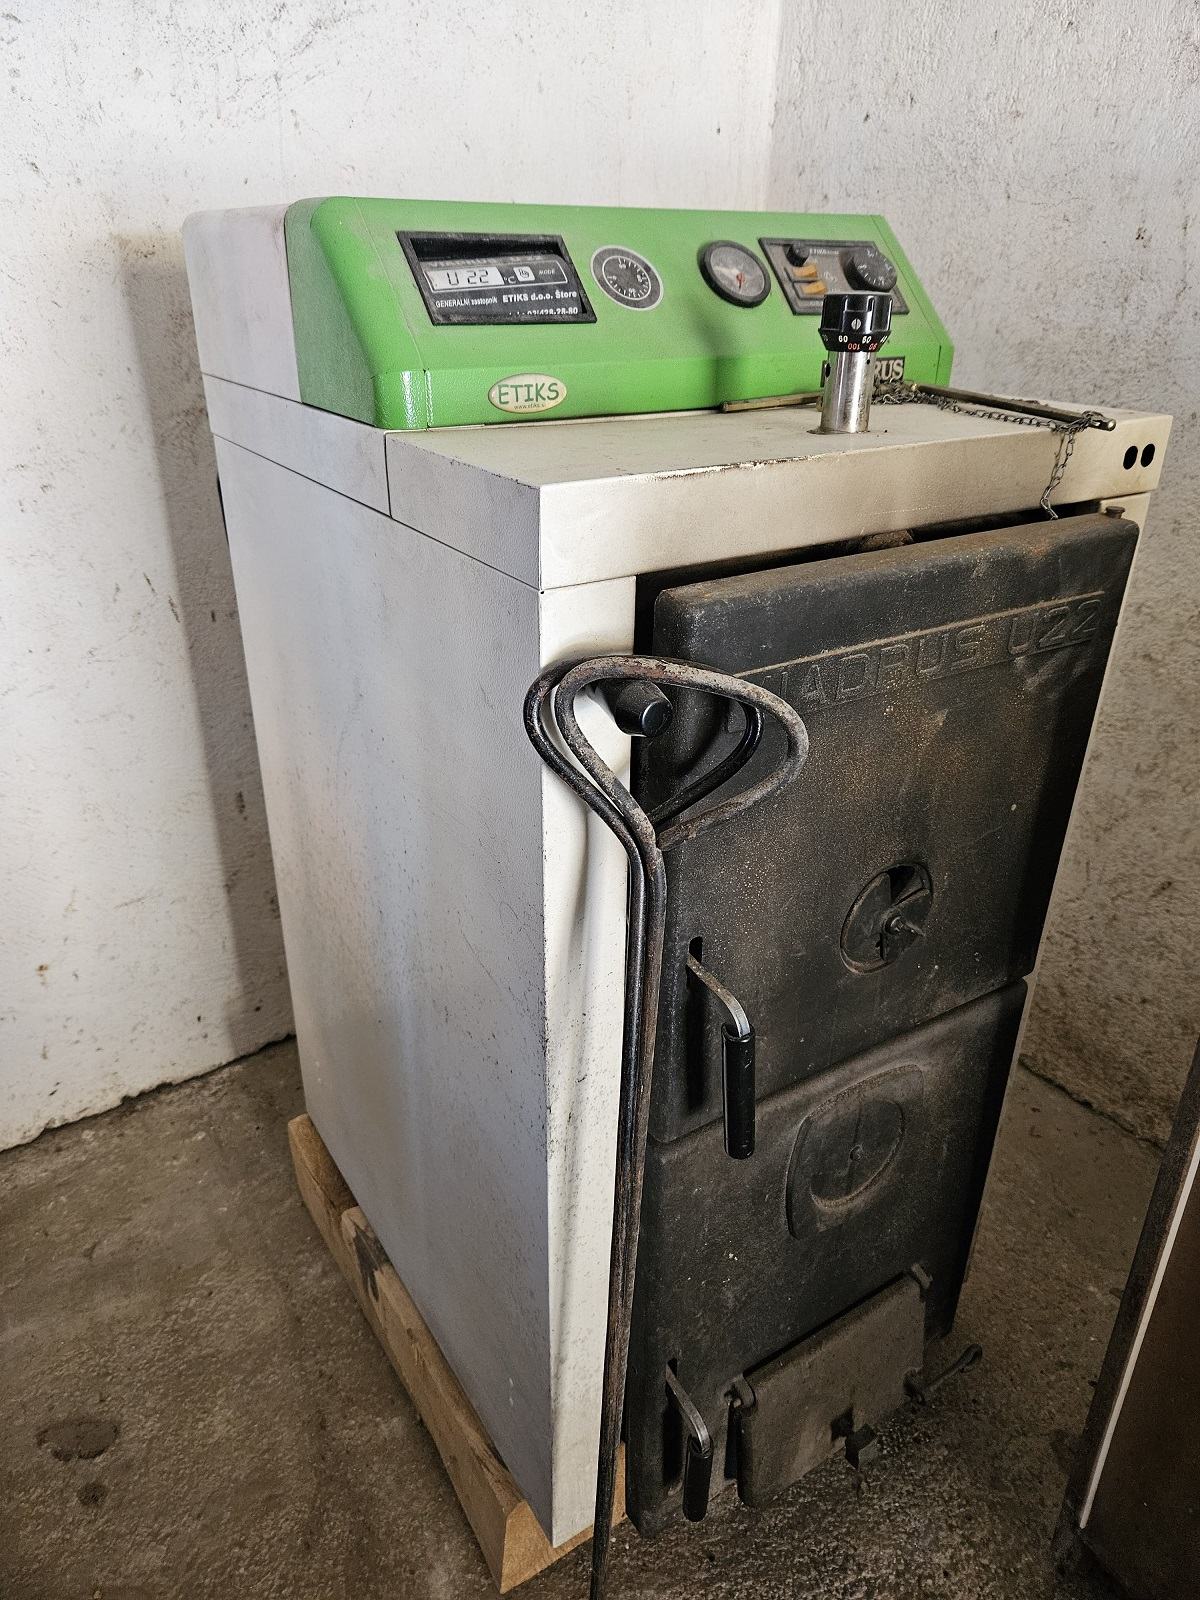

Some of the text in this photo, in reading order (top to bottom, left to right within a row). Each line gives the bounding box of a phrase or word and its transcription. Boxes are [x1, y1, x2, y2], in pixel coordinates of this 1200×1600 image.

[467, 269, 489, 285] 22
[502, 293, 529, 303] ETIKS
[838, 335, 848, 343] 60
[497, 382, 560, 404] ETIKS
